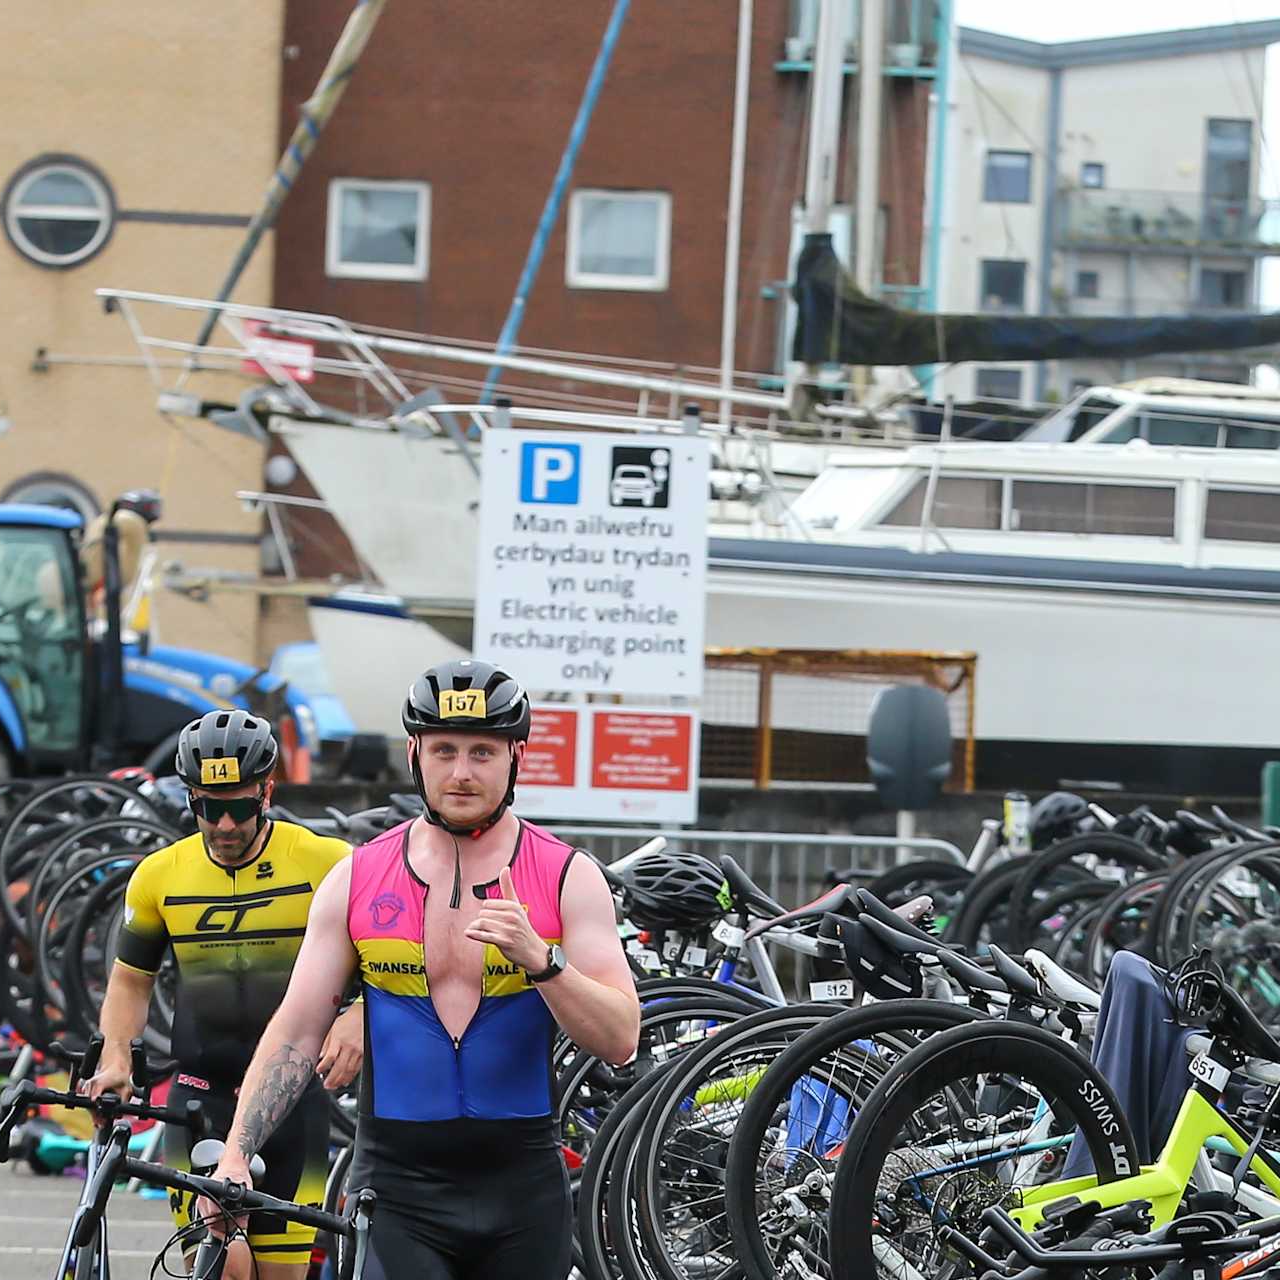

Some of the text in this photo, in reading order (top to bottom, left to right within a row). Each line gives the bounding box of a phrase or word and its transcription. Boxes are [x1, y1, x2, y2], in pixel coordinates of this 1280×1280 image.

[533, 448, 575, 499] P
[513, 513, 673, 538] Man ailwefru
[494, 542, 690, 569] cerbydau trydan
[547, 574, 635, 598] yn unig
[500, 599, 678, 625] Electric vehicle
[490, 628, 686, 656] recharging point
[561, 660, 613, 684] only
[446, 695, 478, 712] 157
[210, 764, 228, 779] 14
[195, 900, 274, 934] CT
[368, 962, 426, 976] SWANSEA
[486, 963, 520, 976] VALE
[1192, 1058, 1216, 1081] 651
[1077, 1078, 1132, 1177] DT SWISS
